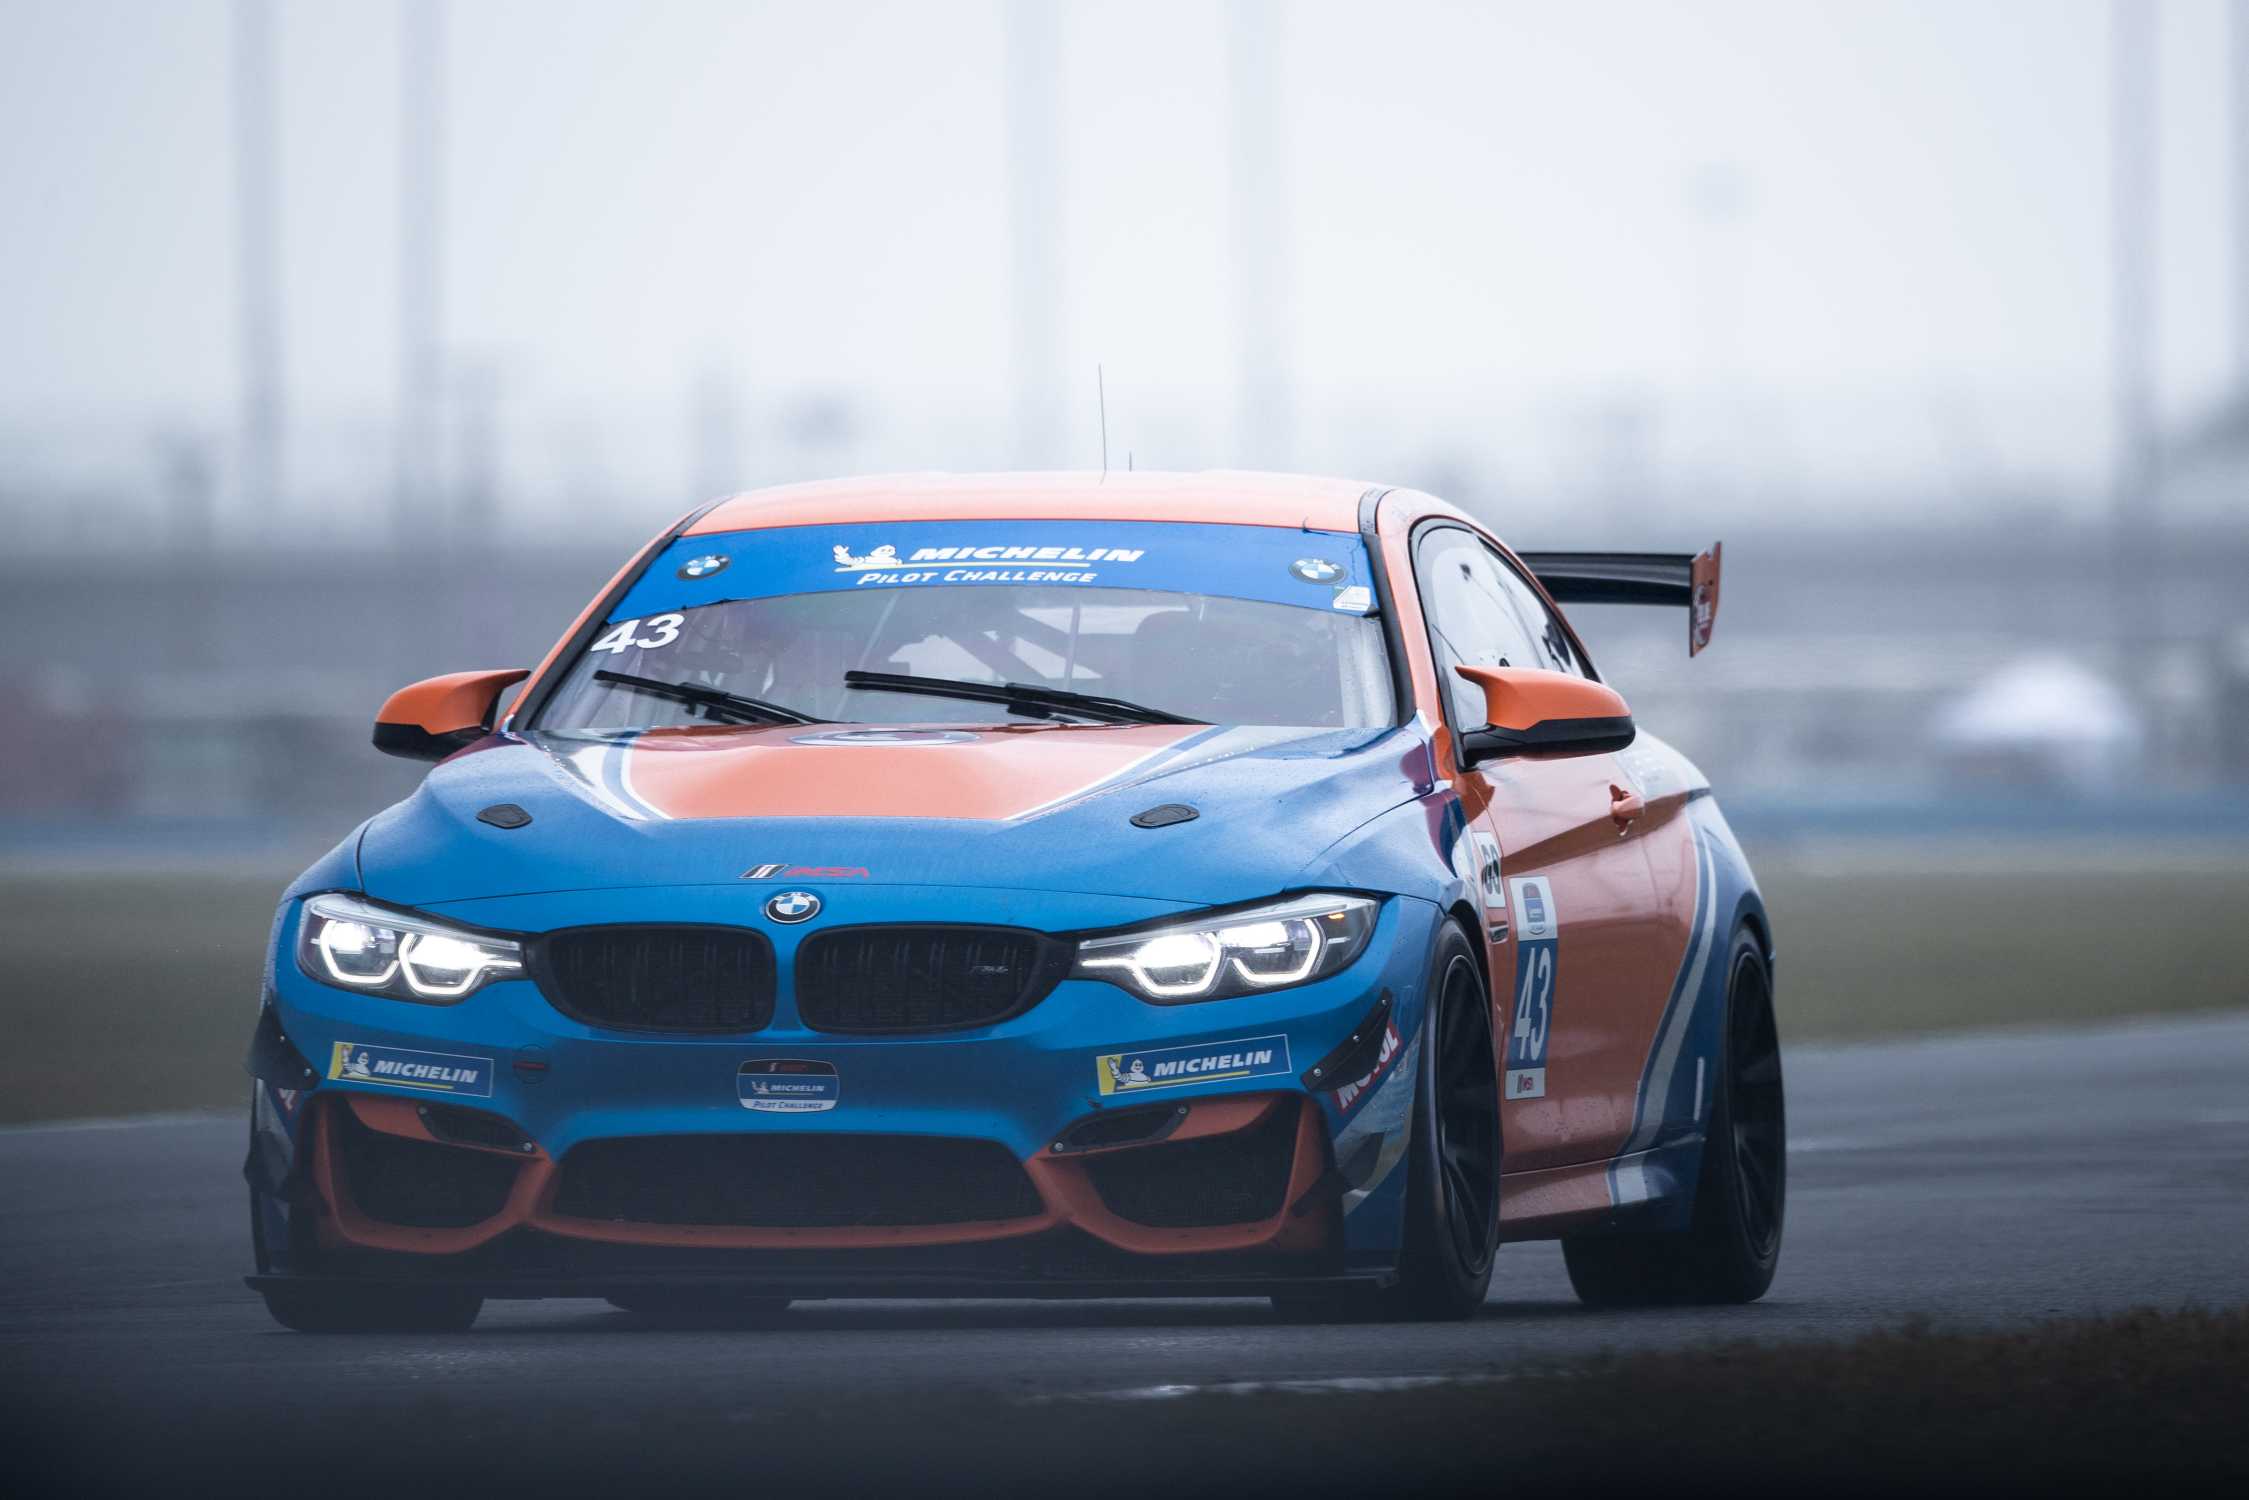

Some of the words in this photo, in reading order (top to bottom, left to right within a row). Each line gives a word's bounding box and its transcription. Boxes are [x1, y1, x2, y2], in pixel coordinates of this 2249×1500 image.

[910, 546, 1145, 562] MICHELIN
[857, 571, 938, 585] PILOT
[944, 569, 1098, 584] CHALLENGE
[590, 613, 685, 654] 43
[1514, 947, 1552, 1061] 43
[373, 1059, 479, 1084] MICHELIN
[1154, 1049, 1273, 1077] MICHELIN
[1336, 1027, 1399, 1110] MUL
[770, 1085, 825, 1093] MICHELIN
